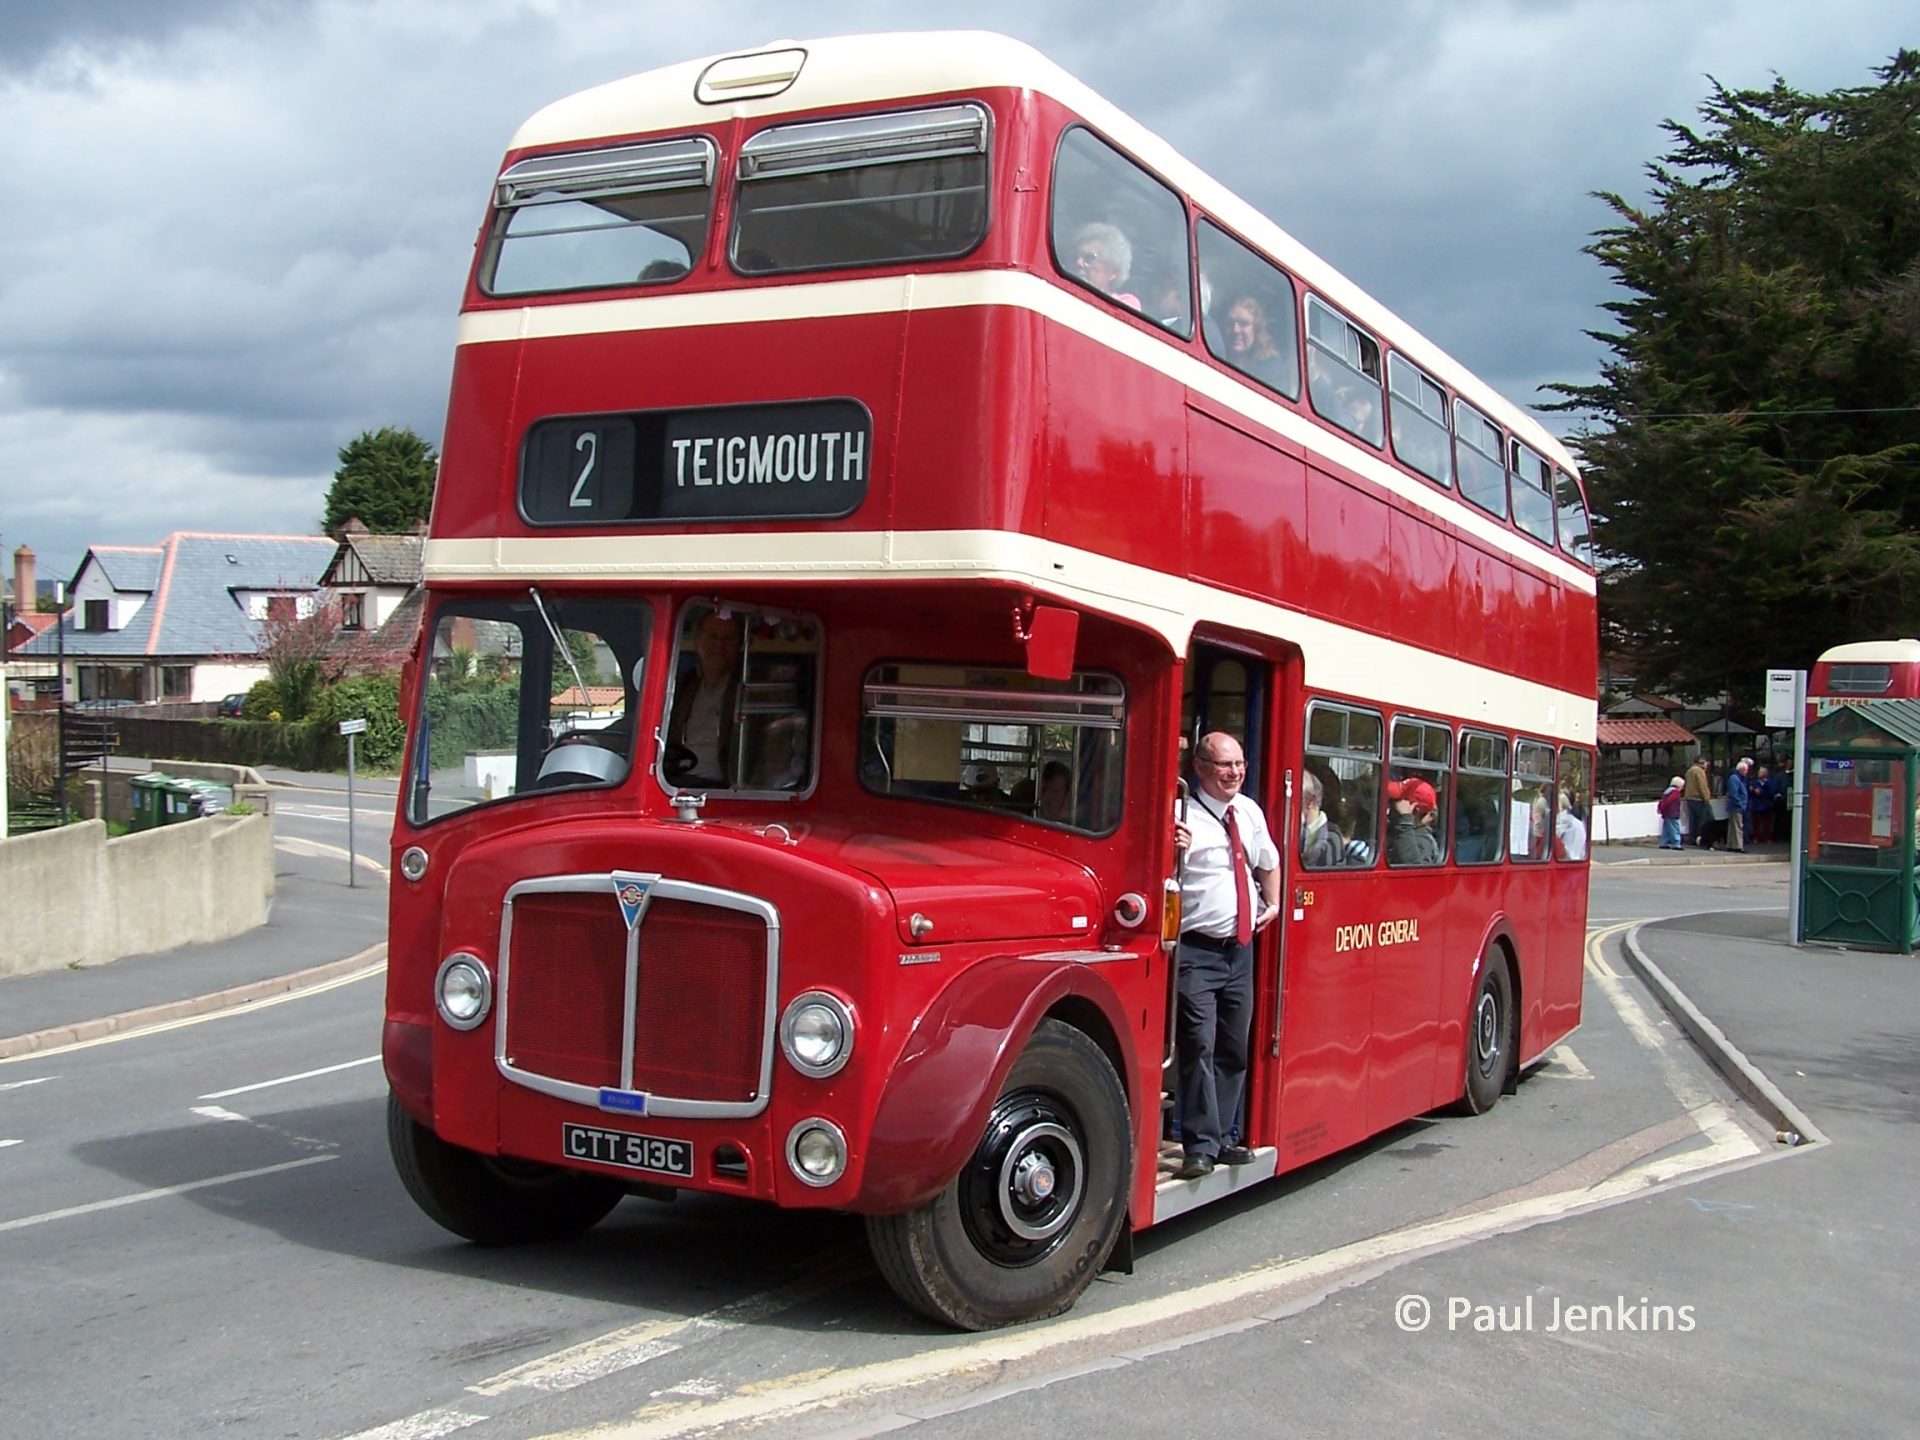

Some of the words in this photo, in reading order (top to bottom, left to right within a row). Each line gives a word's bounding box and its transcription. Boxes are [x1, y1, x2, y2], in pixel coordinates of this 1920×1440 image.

[569, 431, 597, 507] 2
[672, 431, 865, 487] TEIGMOUTH
[1335, 923, 1373, 952] DEVON
[1378, 918, 1419, 946] GENERAL
[570, 1129, 620, 1161] CTT
[626, 1136, 684, 1171] 513C
